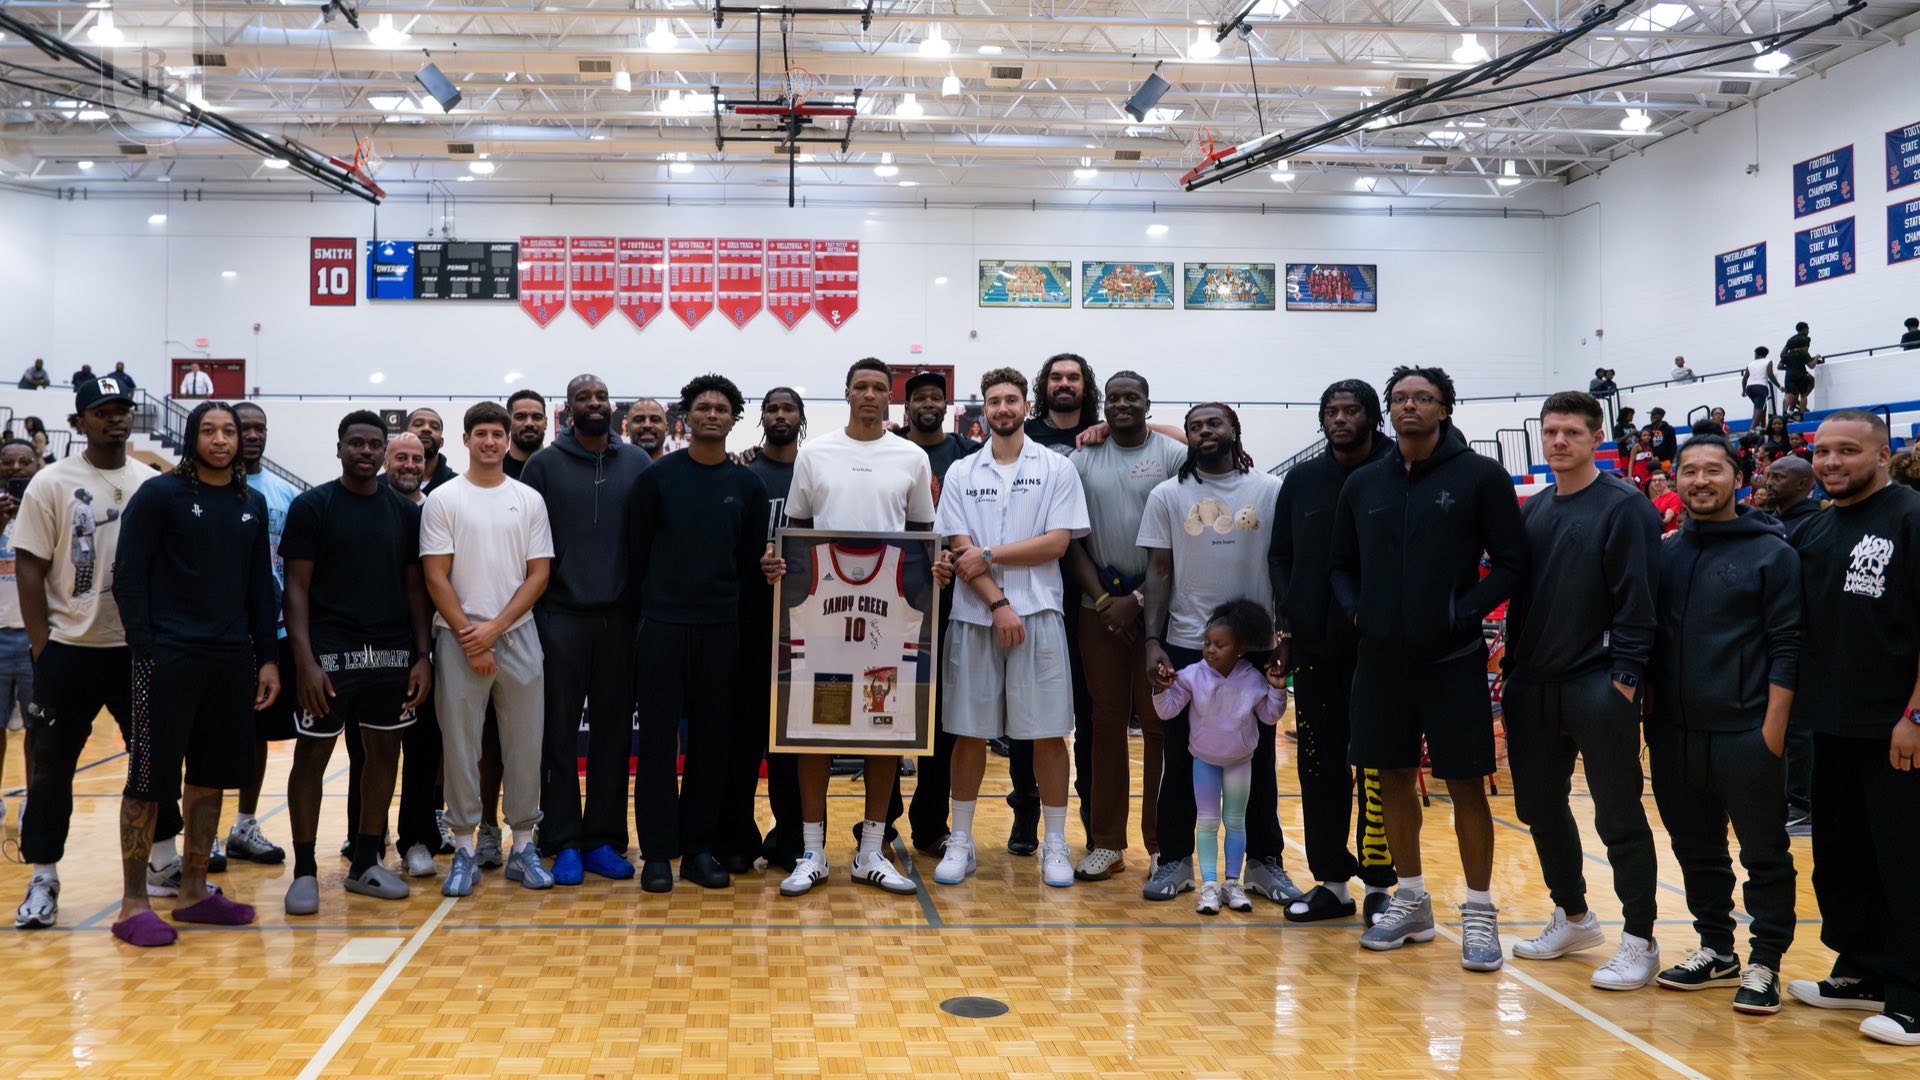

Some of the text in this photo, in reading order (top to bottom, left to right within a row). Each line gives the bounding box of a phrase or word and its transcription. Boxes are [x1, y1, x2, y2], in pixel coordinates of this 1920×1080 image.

[1900, 139, 1919, 154] STATE
[1809, 153, 1836, 171] FOOTBALL
[1806, 171, 1822, 185] STATE
[1808, 181, 1837, 198] CHAMPIONS
[1815, 197, 1831, 210] 2009
[1810, 224, 1838, 240] FOOTBALL
[417, 243, 442, 251] GUEST
[491, 244, 513, 252] HOME
[627, 241, 656, 249] FOOTBALL
[1809, 240, 1824, 254] STATE
[314, 248, 353, 260] SMITH
[1723, 246, 1757, 264] CHEERLEADING
[1809, 251, 1839, 267] CHAMPIONS
[1726, 264, 1740, 276] STATE
[1818, 267, 1830, 279] 2010
[317, 266, 349, 295] 10
[1727, 273, 1753, 288] CHAMPIONS
[389, 414, 398, 424] G
[980, 488, 998, 496] BEN
[1843, 580, 1886, 598] DRAGONS
[822, 595, 888, 618] SANDY CREEK
[844, 616, 866, 642] 10
[320, 653, 339, 672] BE
